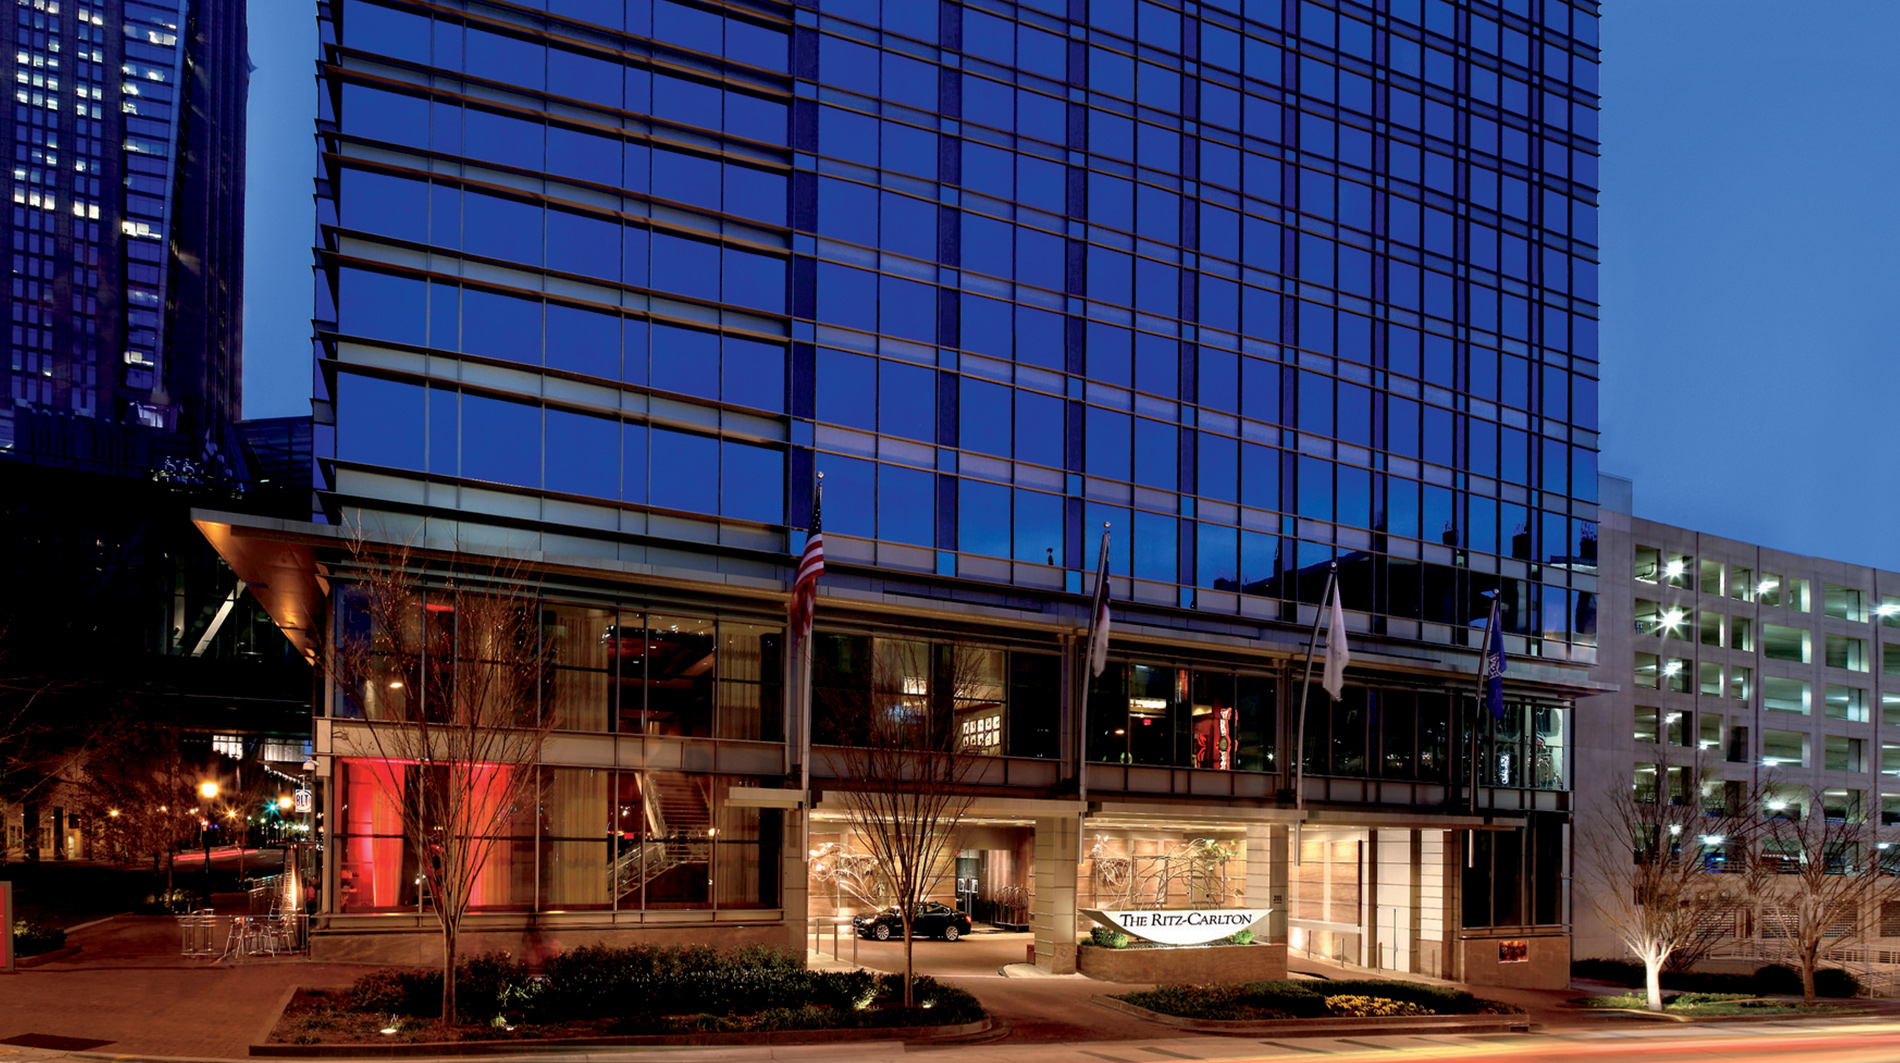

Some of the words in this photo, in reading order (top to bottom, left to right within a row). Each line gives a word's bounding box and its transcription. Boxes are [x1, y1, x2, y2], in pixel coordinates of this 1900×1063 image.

[296, 794, 309, 807] BLT
[1119, 913, 1148, 927] THE
[1151, 912, 1253, 926] RITZ-CARLTON
